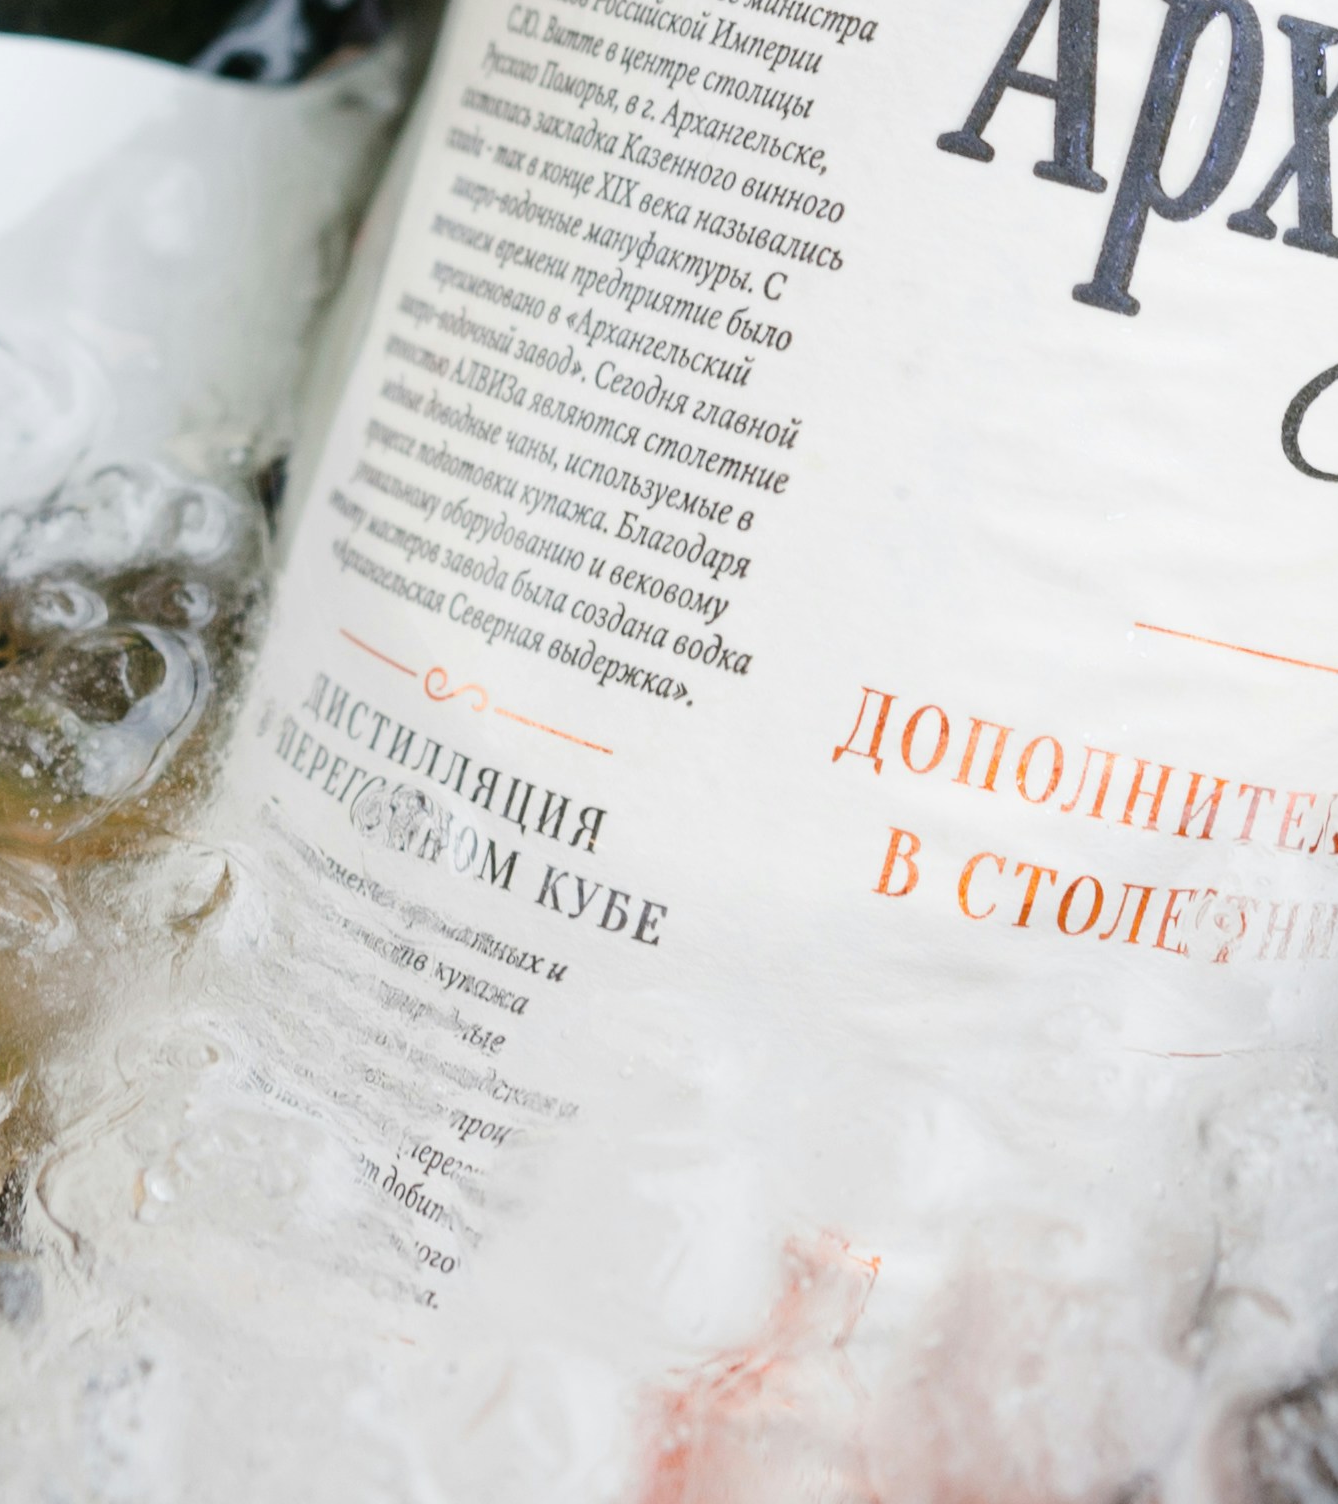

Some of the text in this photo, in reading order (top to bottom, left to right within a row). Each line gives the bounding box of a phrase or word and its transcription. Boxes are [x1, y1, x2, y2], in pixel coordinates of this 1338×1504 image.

[542, 14, 604, 59] Витте
[605, 42, 620, 63] в
[619, 45, 700, 90] центре
[703, 67, 815, 120] столицы
[708, 17, 823, 74] Империи
[532, 117, 619, 156] закладка
[618, 130, 737, 193] Казенного
[740, 175, 846, 223] винного
[539, 59, 619, 115] Поморья,
[624, 94, 640, 116] в
[641, 99, 656, 122] г.
[660, 98, 827, 176] Архангельске,
[526, 155, 541, 176] в
[539, 159, 596, 199] конце
[595, 170, 641, 209] XIX
[638, 191, 693, 225] века
[693, 207, 844, 271] назывались
[582, 221, 754, 292] мануфактуры.
[763, 270, 788, 302] С
[493, 237, 571, 281] времени
[570, 263, 723, 331] предприятие
[725, 306, 794, 352] было
[546, 303, 562, 325] в
[565, 306, 757, 387] «Архангельский
[422, 387, 503, 446] доводные
[505, 428, 559, 473] чаны,
[564, 450, 734, 527] используемые
[736, 509, 756, 533] в
[449, 356, 528, 408] АЛВИЗа
[527, 391, 642, 448] являются
[643, 431, 791, 495] столетние
[594, 359, 691, 415] Сегодня
[692, 399, 803, 451] главной
[415, 439, 519, 501] подготовки
[518, 483, 609, 534] купажа.
[614, 510, 752, 582] Благодаря
[440, 496, 585, 572] оборудованию
[587, 556, 608, 580] и
[608, 563, 730, 626] вековому
[441, 548, 509, 592] завода
[510, 568, 569, 615] была
[570, 600, 671, 649] создана
[672, 632, 754, 676] водка
[448, 592, 546, 655] Северная
[547, 638, 694, 709] выдержка».
[302, 671, 609, 856] ДИСТИЛЛЯЦИЯ
[533, 862, 669, 948] КУБЕ
[871, 825, 923, 898] В
